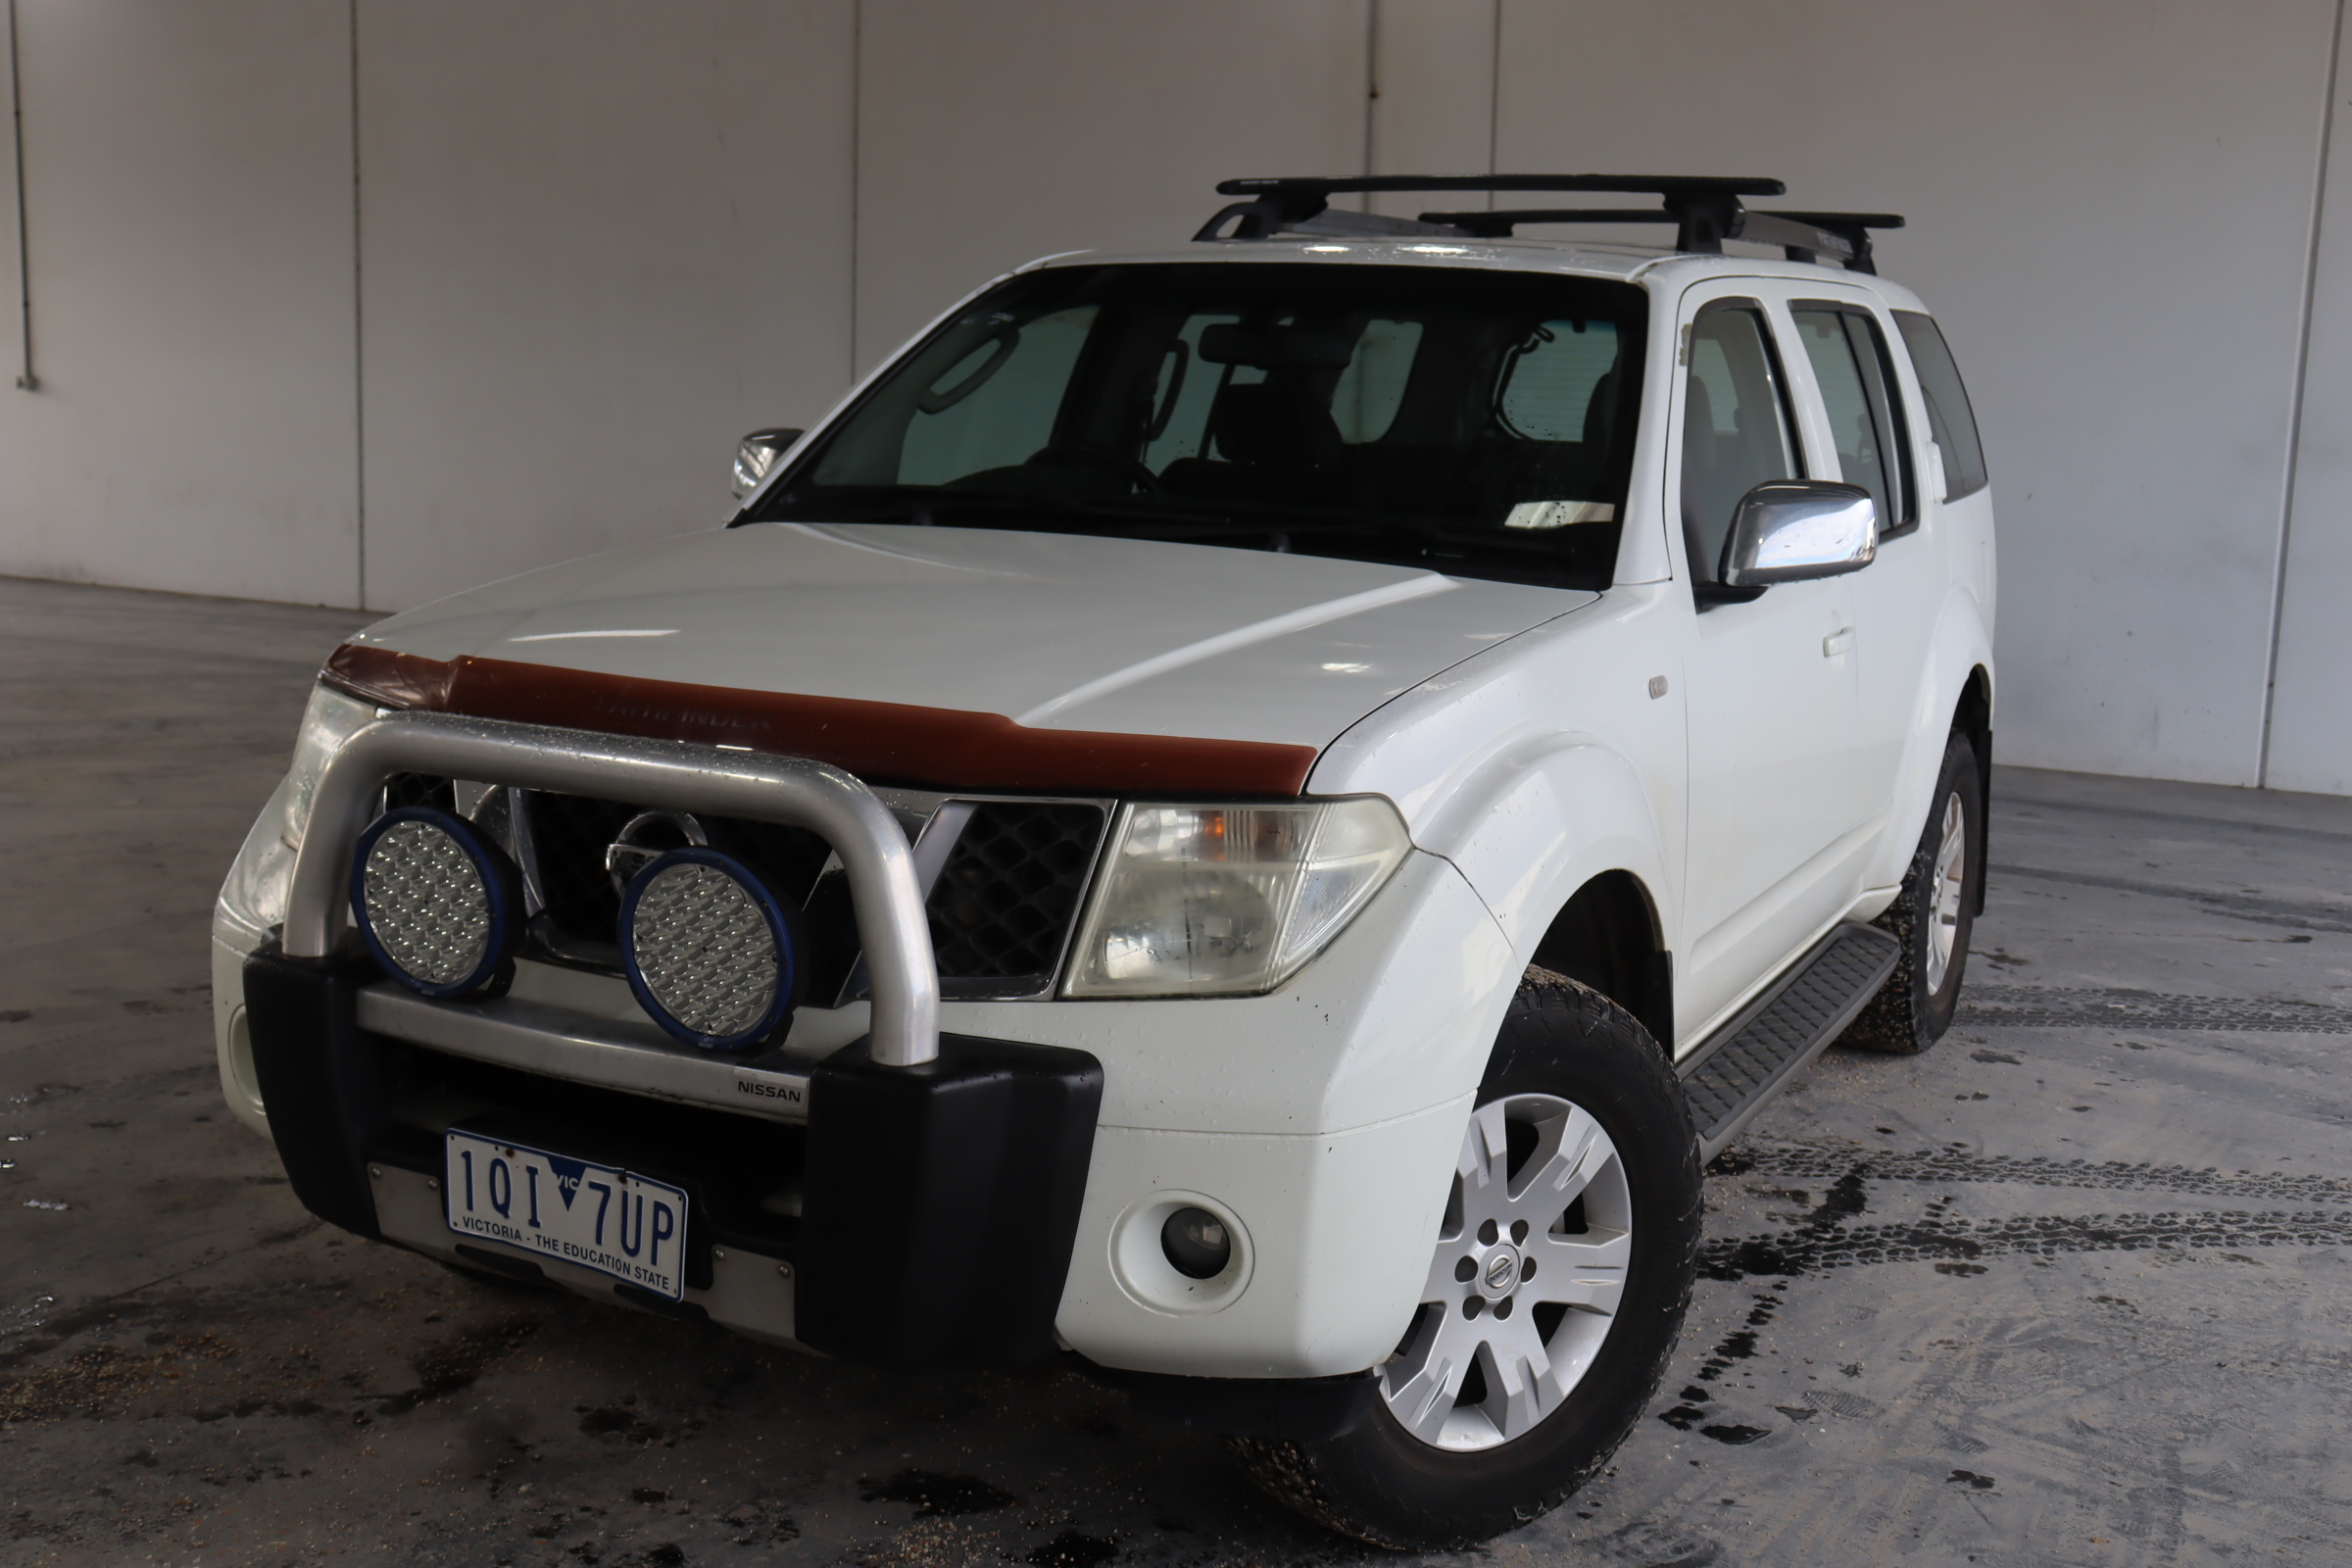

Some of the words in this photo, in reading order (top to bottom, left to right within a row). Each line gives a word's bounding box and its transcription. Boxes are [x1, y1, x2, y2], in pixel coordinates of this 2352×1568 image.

[738, 1081, 801, 1102] NISSAN
[556, 1174, 579, 1192] VIC
[461, 1150, 542, 1229] 1QI
[588, 1181, 674, 1267] 7UP
[462, 1215, 522, 1242] VICTORIA
[535, 1234, 560, 1251] THE
[564, 1242, 631, 1276] EDUCATION
[634, 1265, 669, 1291] STATE
